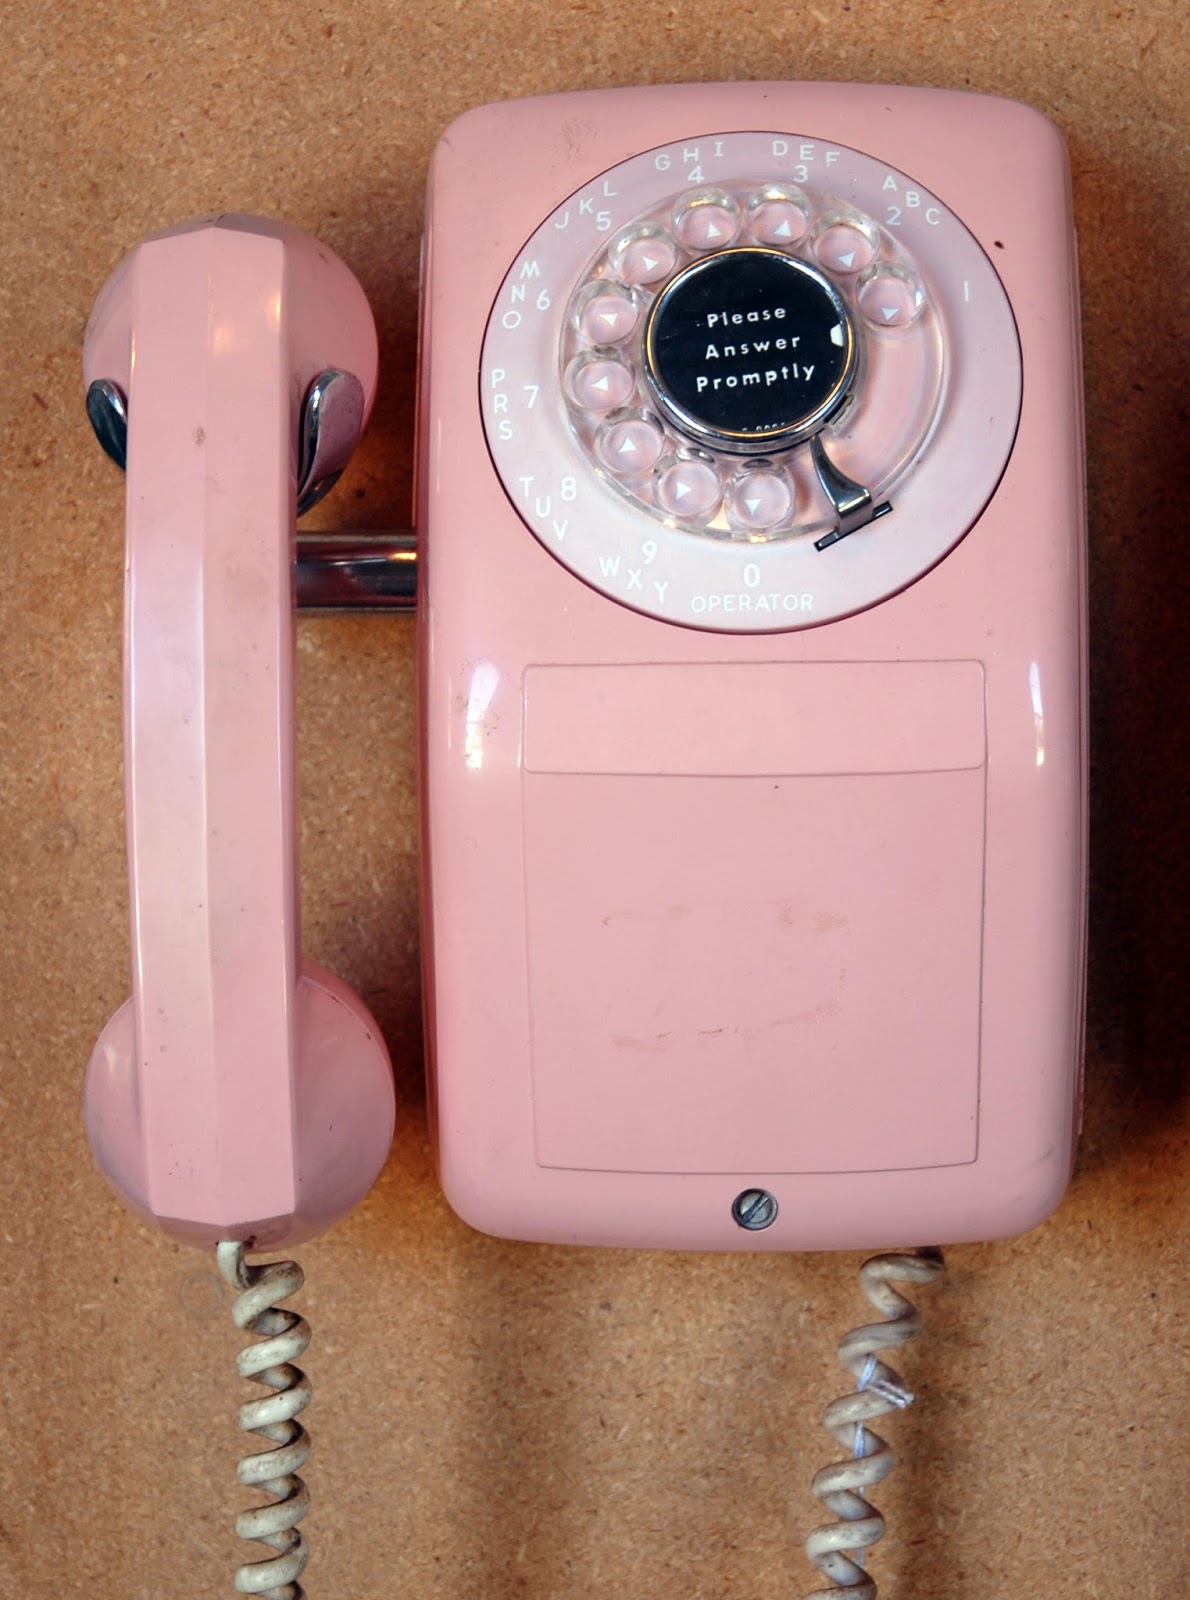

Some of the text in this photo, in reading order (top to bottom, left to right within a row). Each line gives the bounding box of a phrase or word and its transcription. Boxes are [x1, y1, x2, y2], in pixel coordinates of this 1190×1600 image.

[688, 166, 704, 184] 4
[793, 165, 809, 183] 3
[596, 211, 611, 231] 5
[885, 206, 902, 226] 2
[536, 289, 551, 311] 6
[707, 307, 786, 328] Please
[705, 336, 801, 360] Answer
[696, 363, 815, 393] Promptly
[523, 385, 539, 409] 7
[560, 476, 577, 502] 8
[642, 541, 658, 565] 9
[690, 592, 815, 613] OPERATOR
